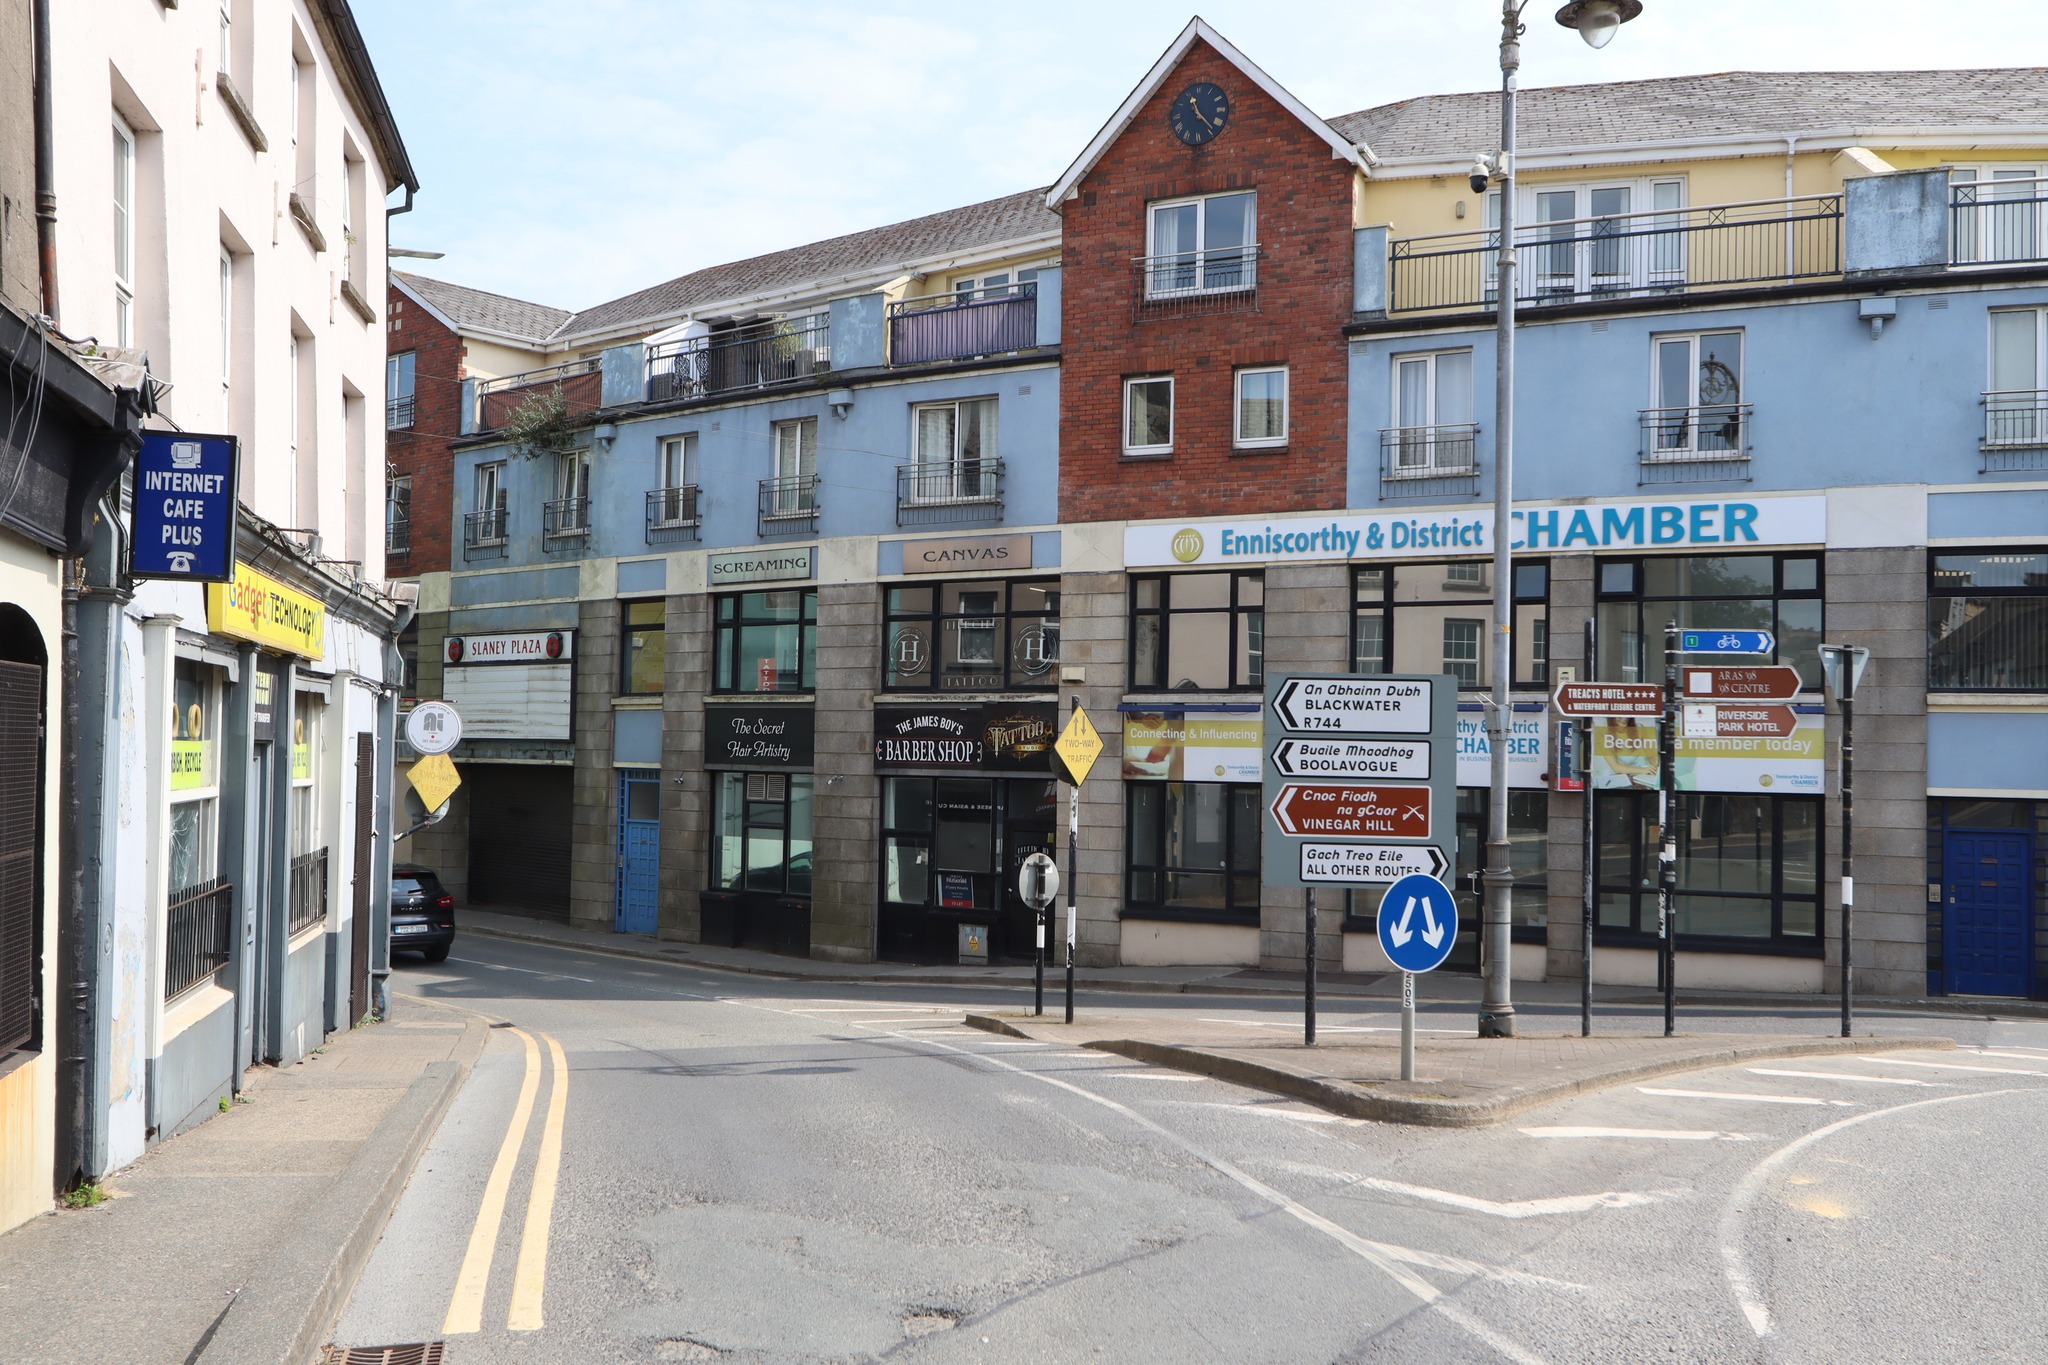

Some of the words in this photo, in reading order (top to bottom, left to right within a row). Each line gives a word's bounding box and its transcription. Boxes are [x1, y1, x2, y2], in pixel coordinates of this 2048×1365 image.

[145, 470, 224, 494] INTERNET
[163, 498, 204, 519] CAFE
[162, 524, 202, 546] PLUS
[1221, 523, 1360, 557] Enniscorthy
[1366, 522, 1385, 550] &
[1391, 517, 1483, 549] District
[923, 547, 1009, 563] CANVAS
[713, 557, 807, 574] SCREAMING
[270, 592, 316, 637] TECHNOLOGY
[471, 641, 507, 656] SLANEY
[511, 639, 542, 654] PLAZA
[1386, 685, 1421, 697] Dubh
[1567, 688, 1600, 699] TREACYS
[1602, 689, 1626, 700] HOTEL
[1731, 683, 1771, 694] CENTRE
[1305, 699, 1401, 711] BLACKWATER
[1573, 702, 1609, 711] WATERFRONT
[1610, 703, 1633, 711] LEISURE
[1634, 703, 1656, 711] CENTRE
[1717, 710, 1769, 720] RIVERSIDE
[731, 718, 751, 734] The
[753, 717, 785, 735] Secret
[895, 717, 912, 735] THE
[913, 715, 939, 729] JAMES
[940, 717, 964, 736] BOY'S
[1717, 722, 1744, 731] PARK
[1747, 722, 1780, 732] HOTEL
[988, 720, 1044, 759] TATTOO
[1130, 727, 1186, 742] Connecting
[1189, 729, 1197, 739] &
[1200, 729, 1258, 742] Influencing
[1064, 739, 1095, 748] TWO-WAY
[1300, 744, 1341, 756] Buaile
[1603, 734, 1659, 749] Becom
[1674, 740, 1683, 751] a
[1688, 736, 1761, 751] member
[1766, 738, 1813, 755] today
[727, 740, 752, 757] Hair
[753, 740, 791, 761] Artistry
[885, 739, 937, 762] BARBER
[937, 740, 974, 763] SHOP
[1067, 754, 1093, 764] TRAFFIC
[1300, 760, 1398, 772] BOOLAVOGUE
[1302, 789, 1336, 801] Cnoc
[1341, 790, 1377, 802] Fiodh
[1336, 806, 1353, 815] na
[1357, 804, 1398, 817] gCaor
[1302, 818, 1361, 830] VINEGAR
[1365, 819, 1395, 831] HILL
[1307, 848, 1340, 860] Gach
[1345, 849, 1373, 861] Treo
[1378, 850, 1403, 861] Eile
[1306, 864, 1327, 875] ALL
[1331, 864, 1370, 876] OTHER
[1374, 865, 1421, 877] ROUTES
